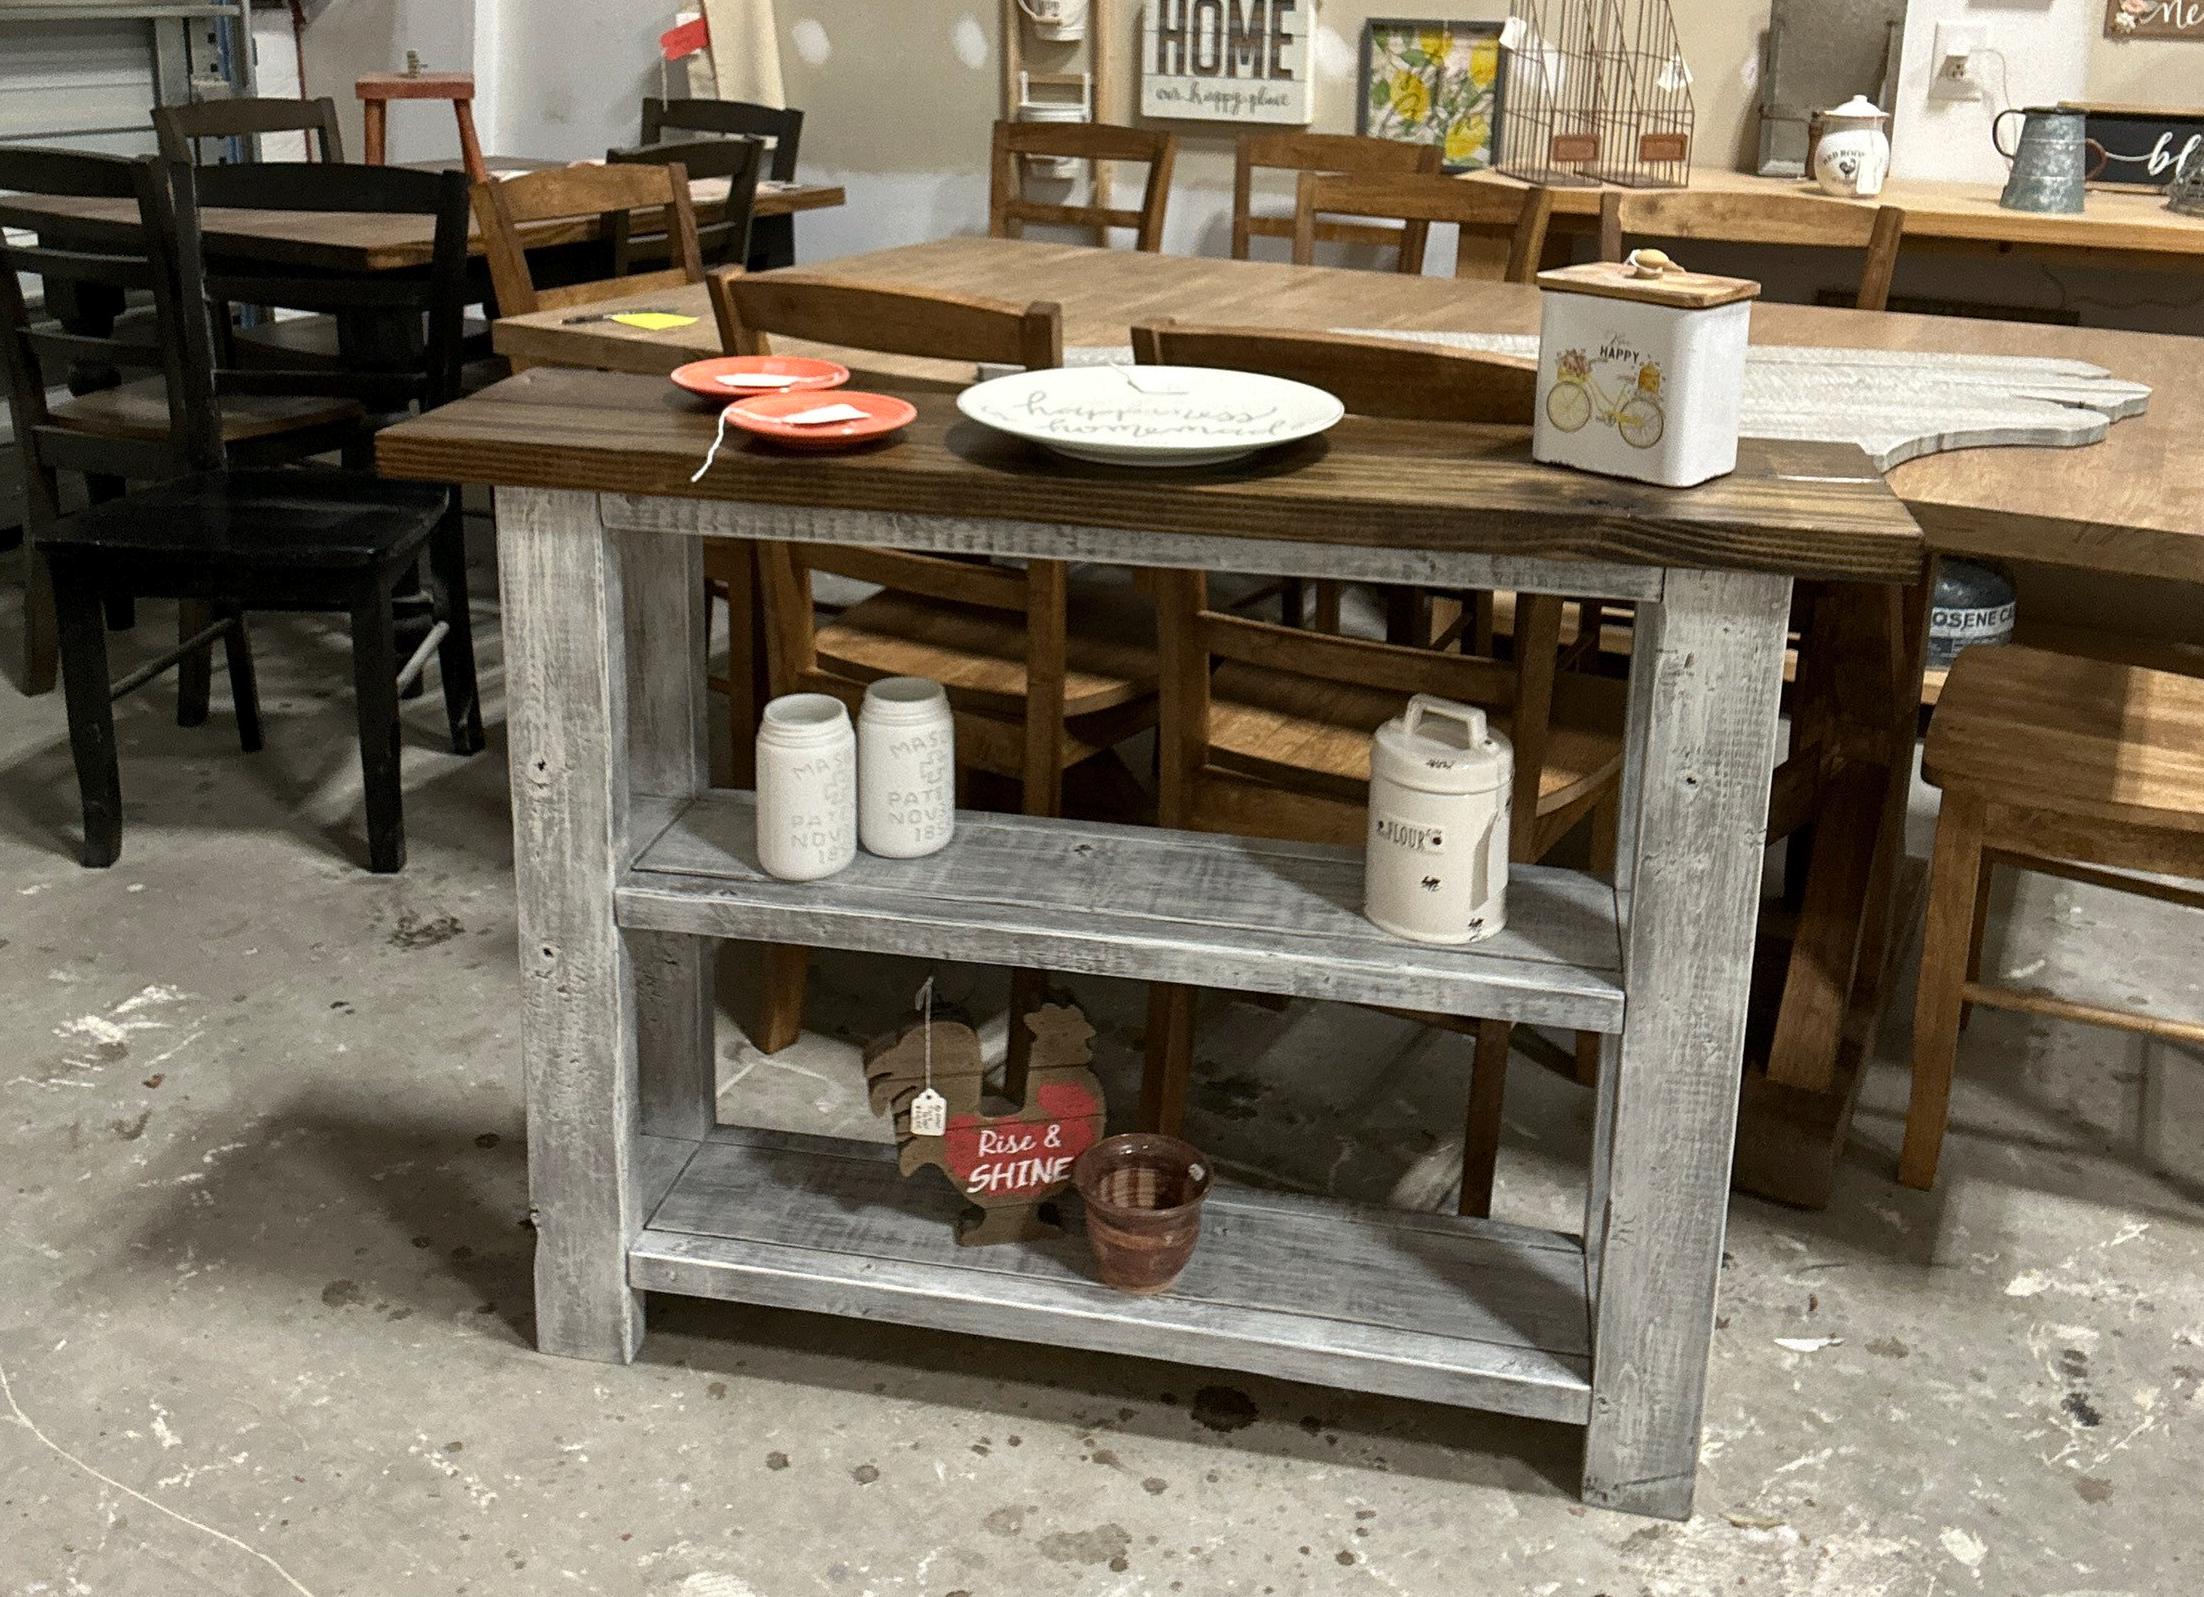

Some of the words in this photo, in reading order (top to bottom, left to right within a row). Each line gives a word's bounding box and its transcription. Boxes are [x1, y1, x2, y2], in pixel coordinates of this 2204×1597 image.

[1158, 0, 1296, 80] HOME
[1184, 81, 1243, 115] happy
[1247, 85, 1292, 115] place
[1599, 345, 1640, 364] HAPPY
[1932, 610, 1997, 631] OSENE
[1387, 821, 1425, 853] FLOUR
[978, 1129, 1038, 1157] Rise
[1043, 1124, 1062, 1148] &
[966, 1155, 1075, 1194] SHINE
